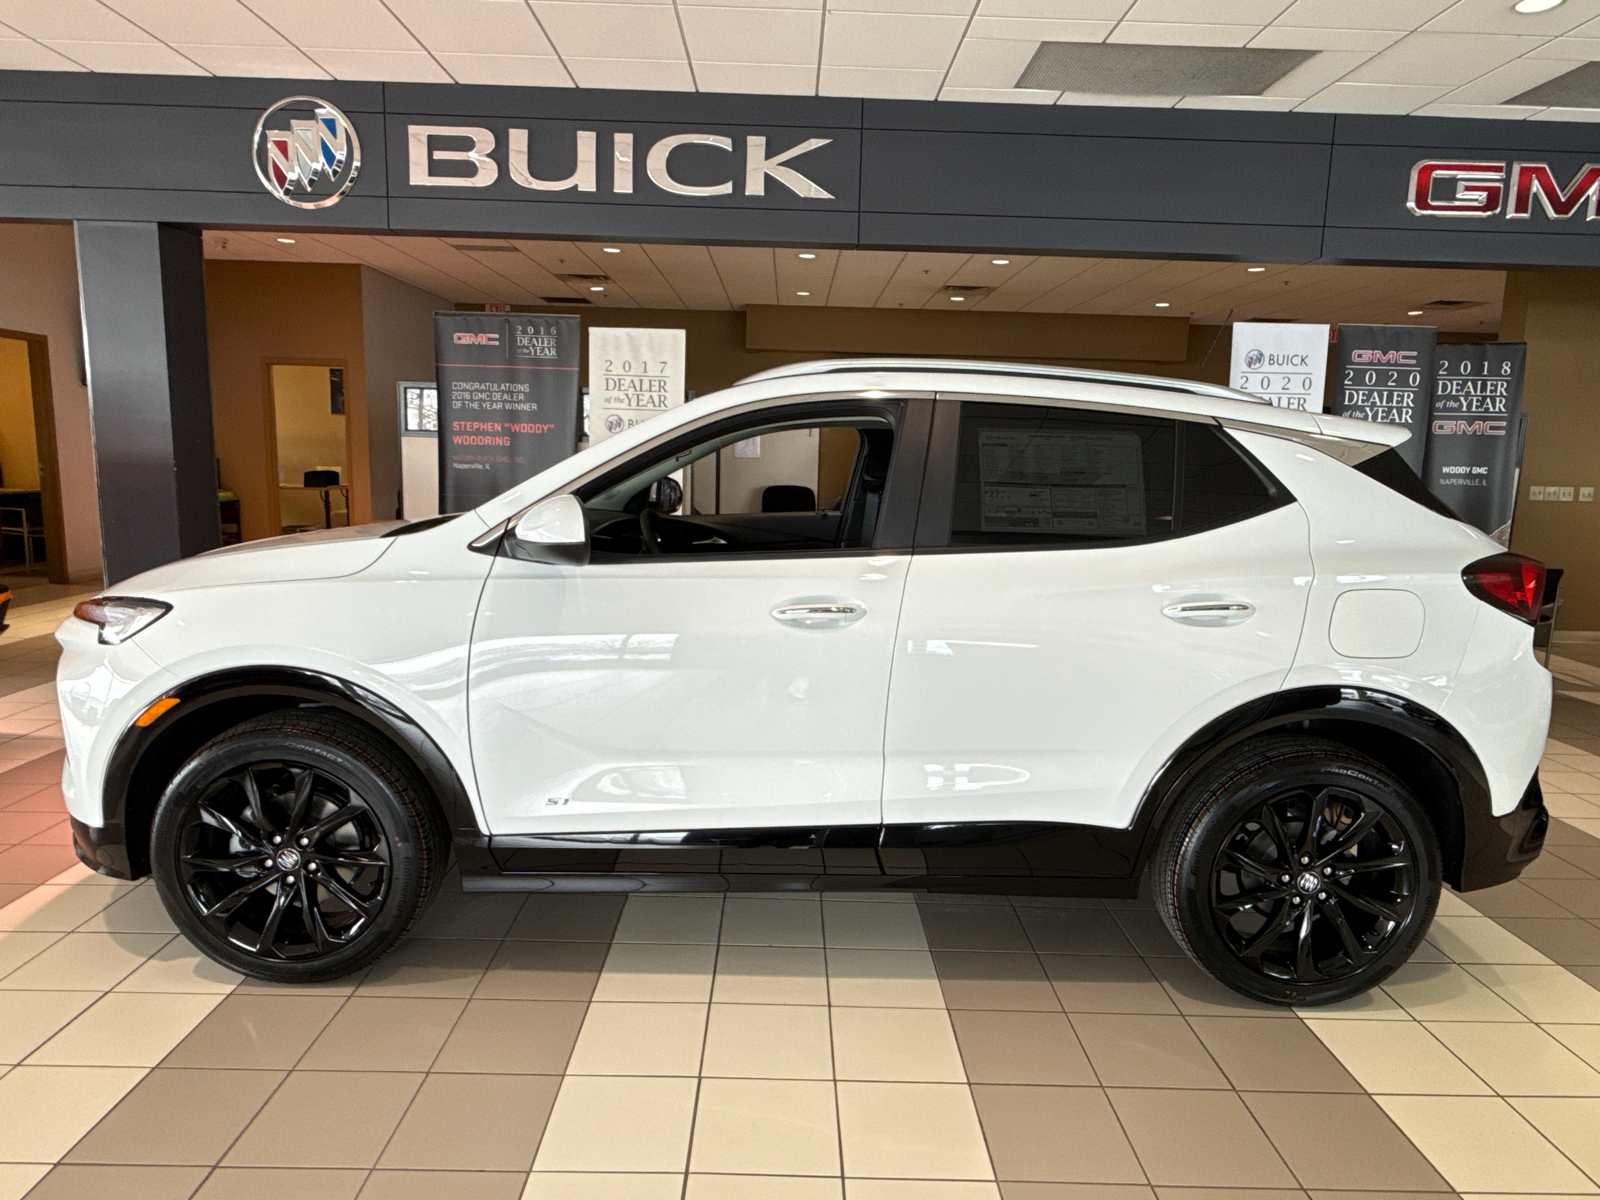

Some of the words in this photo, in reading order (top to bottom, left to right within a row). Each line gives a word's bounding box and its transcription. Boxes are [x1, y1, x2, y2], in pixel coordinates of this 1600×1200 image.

[407, 124, 835, 199] BUICK
[516, 326, 557, 335] 2016
[453, 333, 500, 346] GMC
[517, 336, 557, 347] DEALER
[529, 346, 557, 356] YEAR
[1352, 349, 1418, 365] GMC
[604, 359, 668, 374] 2017
[1268, 354, 1309, 366] BUICK
[1438, 360, 1511, 376] 2018
[604, 377, 668, 393] DEALER
[1240, 375, 1313, 391] 2020
[1344, 370, 1420, 387] 2020
[452, 382, 530, 392] CONGRATULATIONS
[1436, 380, 1508, 396] DEALER
[452, 391, 471, 400] 2016
[472, 392, 491, 401] GMC
[492, 392, 525, 401] DEALER
[604, 396, 613, 404] of
[613, 396, 625, 404] the
[624, 393, 668, 408] YEAR
[1344, 390, 1414, 407] DEALER
[452, 401, 463, 410] OF
[464, 401, 480, 410] THE
[481, 402, 503, 411] YEAR
[504, 403, 538, 412] WINNER
[1435, 400, 1446, 409] of
[1446, 400, 1460, 409] the
[1459, 397, 1507, 412] YEAR
[1342, 410, 1351, 418] of
[1351, 410, 1365, 419] the
[1364, 407, 1413, 423] YEAR
[452, 421, 502, 432] STEPHEN
[1432, 420, 1507, 435] GMC
[452, 435, 511, 447] WOODRING
[1442, 466, 1470, 474] WOODY
[1472, 466, 1488, 475] GMC
